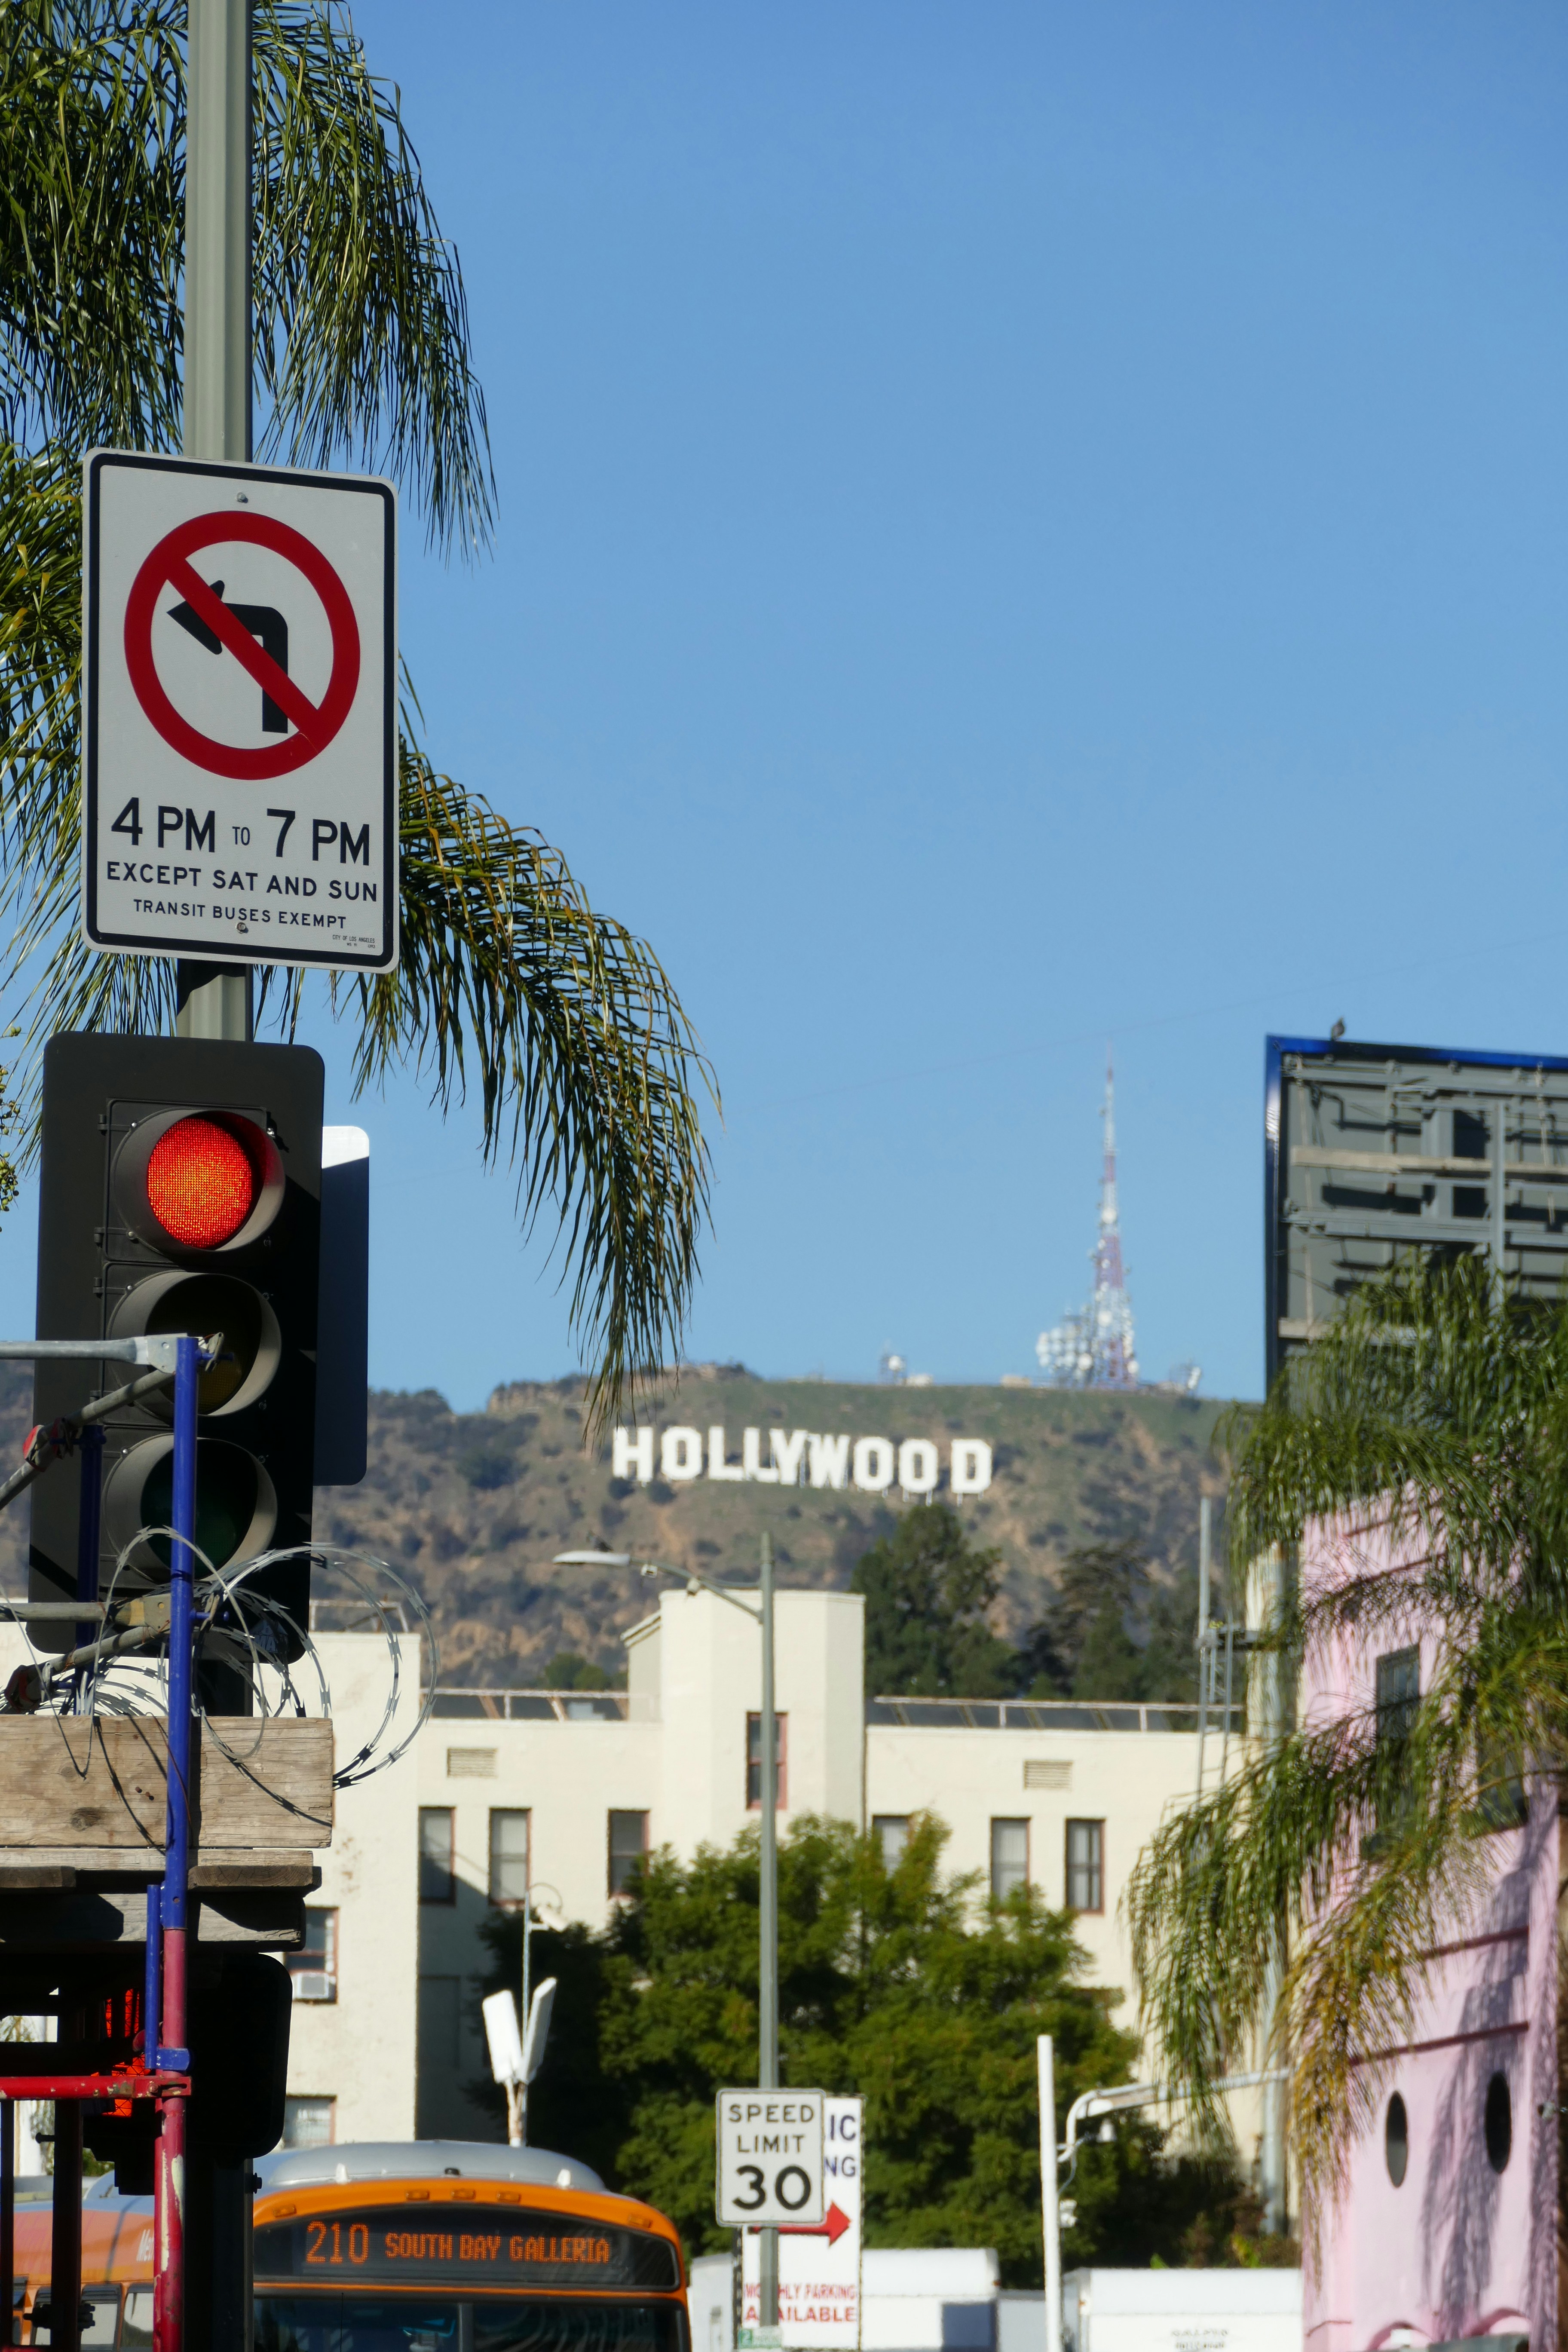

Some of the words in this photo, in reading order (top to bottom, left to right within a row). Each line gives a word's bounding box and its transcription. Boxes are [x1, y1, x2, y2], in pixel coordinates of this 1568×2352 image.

[111, 797, 143, 845] 4
[158, 805, 215, 853] PM
[233, 826, 250, 845] TO
[267, 808, 296, 858] 7
[312, 819, 370, 866] PM
[107, 861, 201, 886] EXCEPT
[212, 870, 258, 891] SAT
[266, 875, 317, 896] AND
[328, 880, 377, 902] SUN
[134, 899, 205, 917] TRANSIT
[213, 906, 271, 922] BUSES
[279, 911, 346, 929] EXEMPT
[612, 1425, 992, 1494] HOLLYWOOD
[729, 2104, 815, 2123] SPEED
[830, 2115, 856, 2141] IC
[737, 2134, 805, 2153] LIMIT
[824, 2156, 856, 2177] NG
[732, 2164, 812, 2211] 30
[306, 2221, 369, 2264] 210
[385, 2233, 453, 2259] SOUTH
[459, 2234, 502, 2261] BAY
[509, 2236, 609, 2264] GALLERIA
[804, 2283, 857, 2300] PARKING
